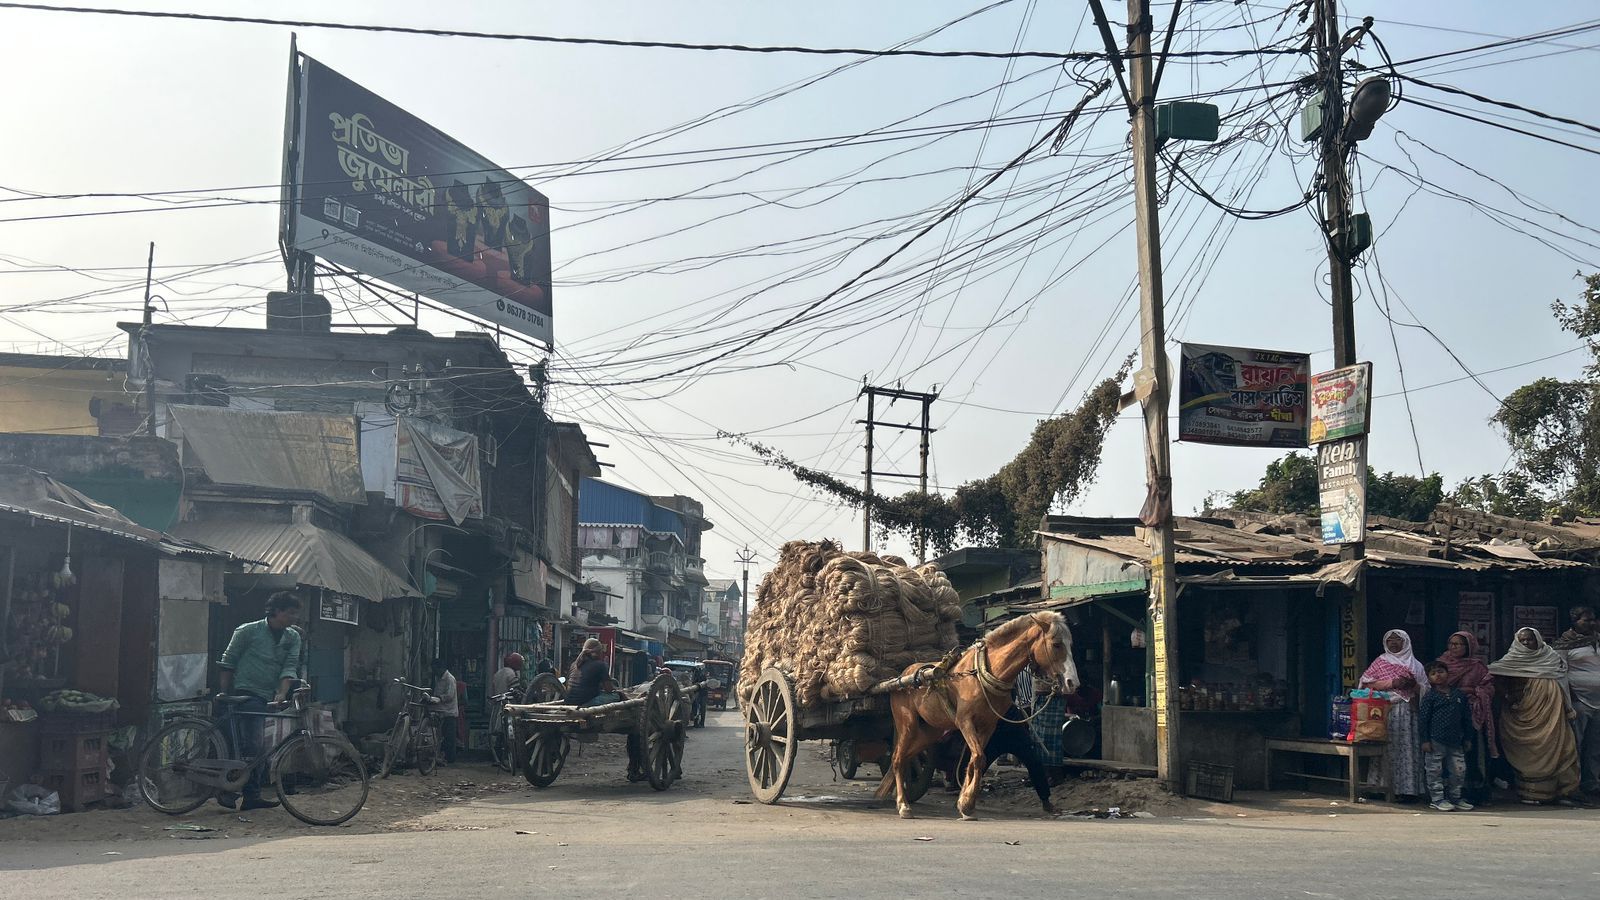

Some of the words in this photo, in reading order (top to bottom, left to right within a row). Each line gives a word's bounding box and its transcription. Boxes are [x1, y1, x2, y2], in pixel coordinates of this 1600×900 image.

[329, 111, 409, 174] প্রতিভা
[507, 303, 526, 320] 86378
[1320, 440, 1362, 466] Relax
[1323, 461, 1359, 479] Family
